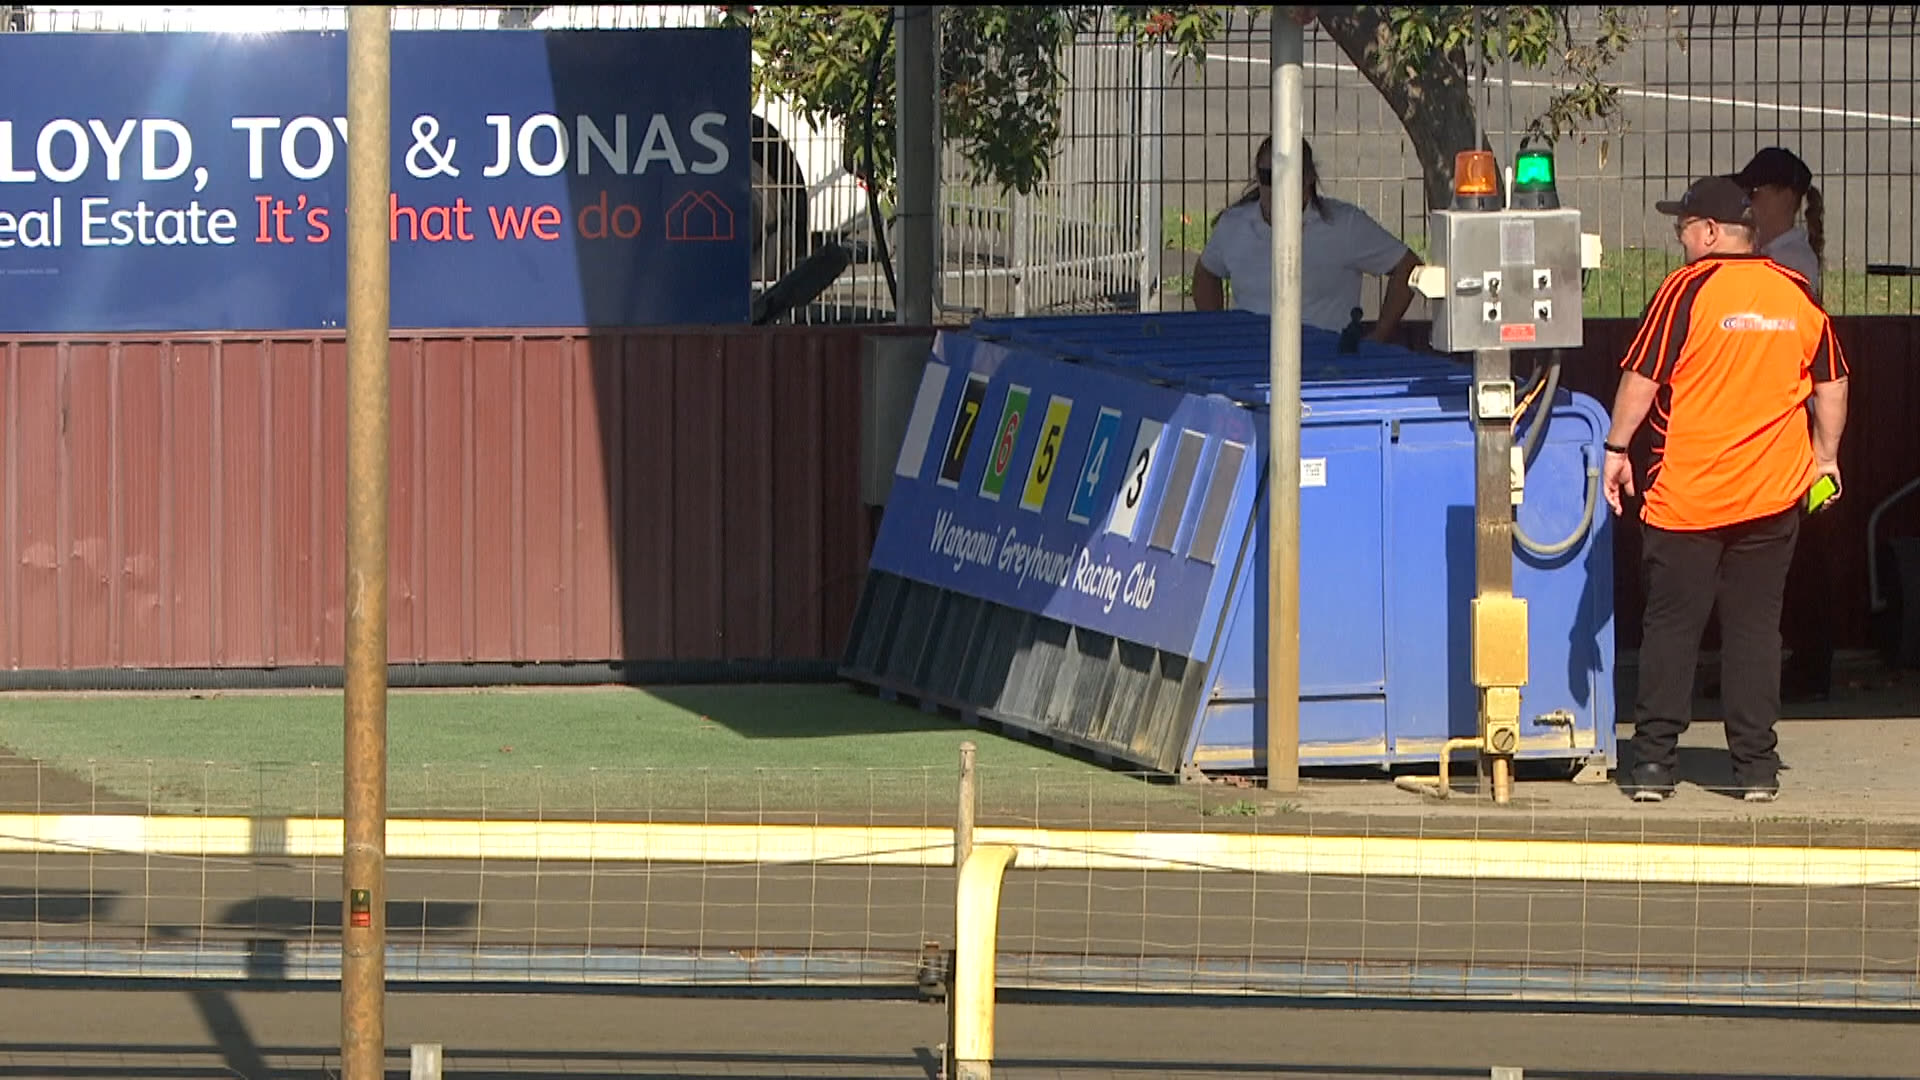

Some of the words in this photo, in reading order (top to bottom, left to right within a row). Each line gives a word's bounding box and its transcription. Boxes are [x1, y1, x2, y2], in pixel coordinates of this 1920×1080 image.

[0, 118, 209, 193] LOYD,
[405, 115, 460, 178] &
[483, 112, 730, 179] JONAS
[81, 197, 237, 247] Estate
[254, 194, 331, 244] It's
[345, 192, 475, 242] hat
[488, 205, 562, 242] we
[577, 190, 641, 240] do
[954, 401, 979, 460] 7
[995, 411, 1020, 476] 6
[1037, 425, 1060, 484] 5
[1086, 437, 1110, 497] 4
[1126, 447, 1150, 509] 3
[930, 508, 1001, 573] Wanganui
[998, 526, 1077, 590] Greyhound
[1072, 547, 1122, 614] Racing
[1123, 561, 1156, 610] Club
